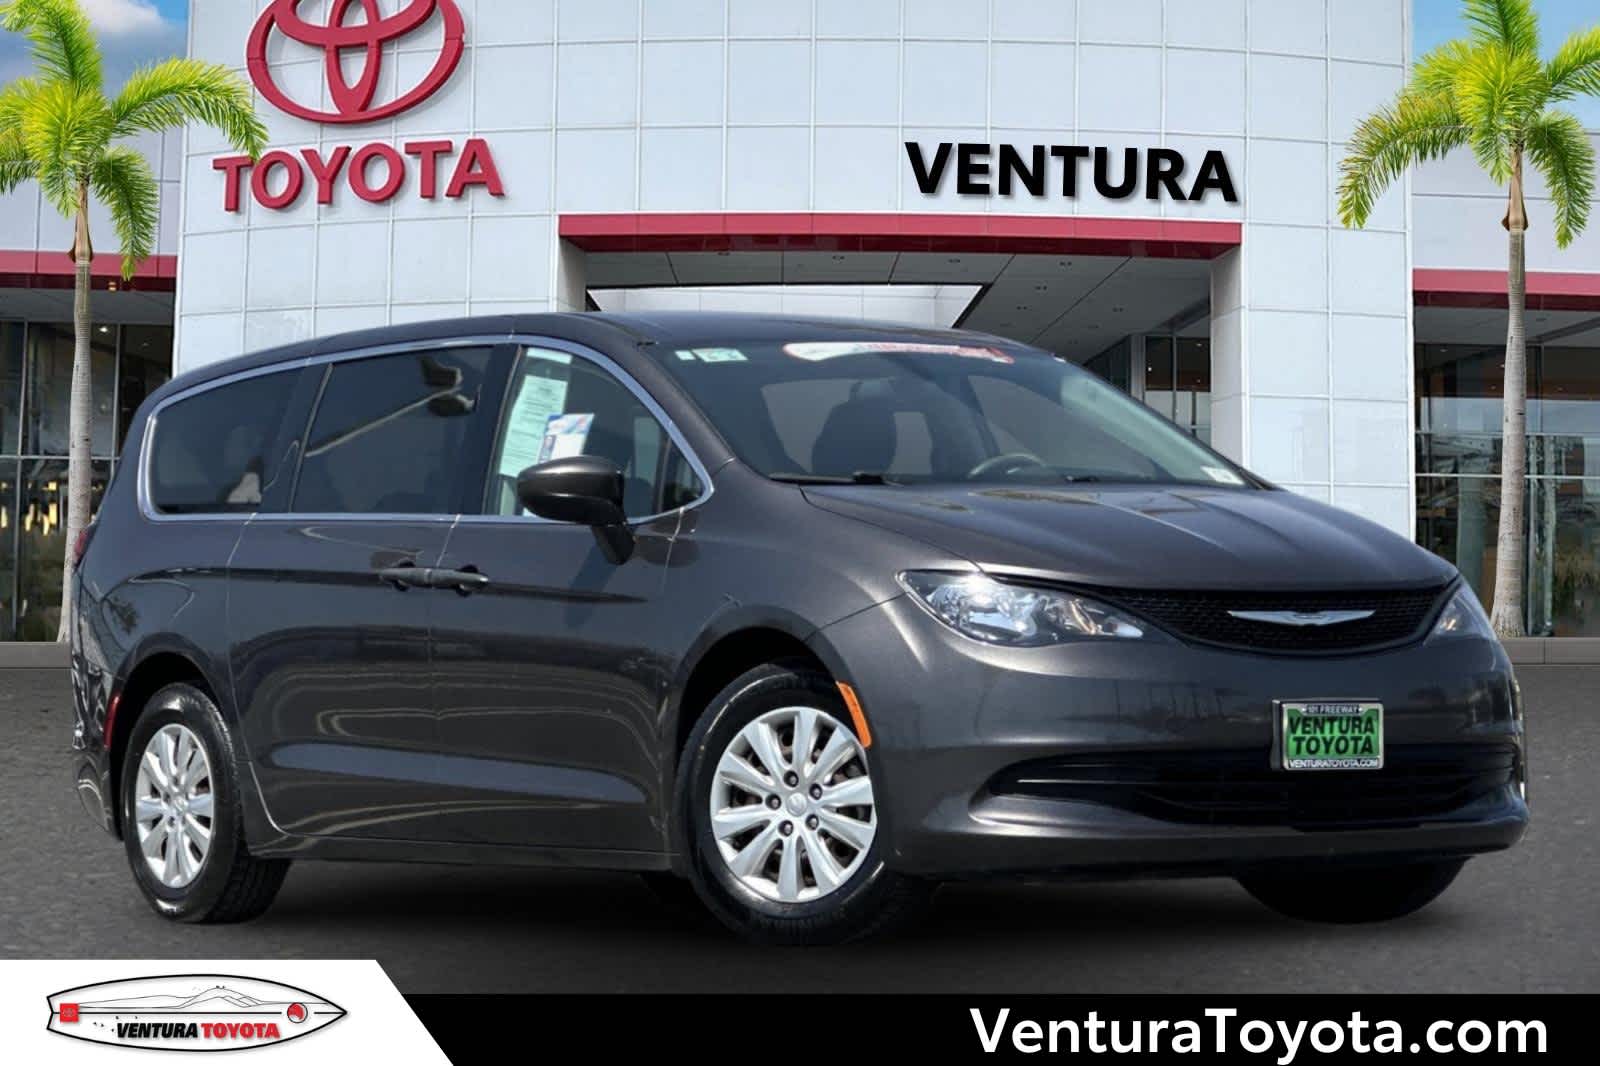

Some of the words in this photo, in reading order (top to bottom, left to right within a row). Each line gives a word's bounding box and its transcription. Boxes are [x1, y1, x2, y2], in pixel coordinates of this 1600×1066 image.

[212, 138, 505, 212] TOYOTA
[904, 141, 1238, 203] VENTURA
[1320, 704, 1358, 713] FREEWAY
[1289, 716, 1375, 734] VENTURA
[1293, 736, 1373, 754] TOYOTA
[1288, 759, 1377, 768] VENTURATOYOTA.COM
